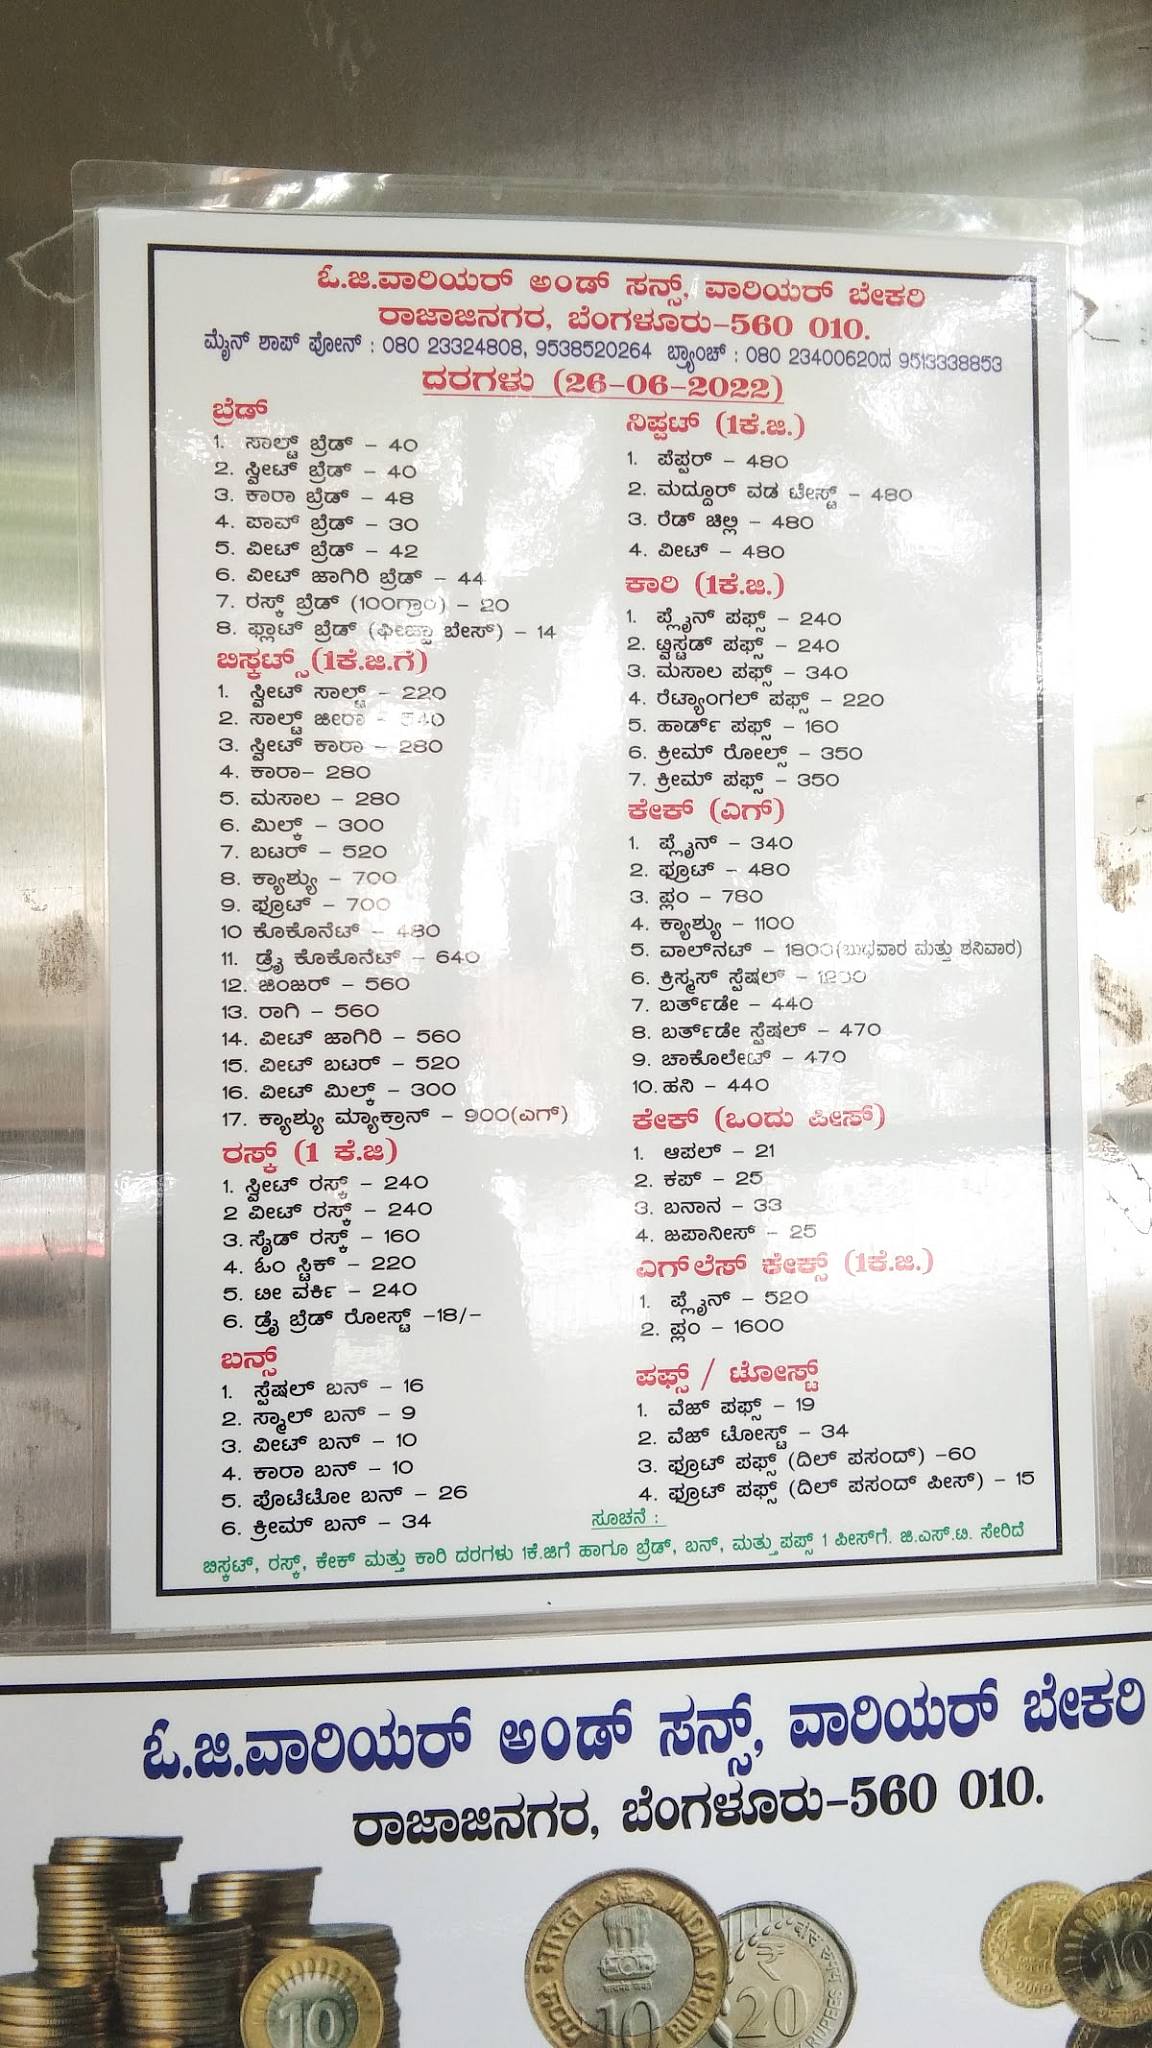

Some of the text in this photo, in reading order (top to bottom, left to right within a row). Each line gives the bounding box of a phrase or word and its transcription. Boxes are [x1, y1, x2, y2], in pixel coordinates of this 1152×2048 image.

[530, 271, 609, 294] ಅಂಡ್
[705, 279, 833, 303] ವಾರಿಯರ್
[849, 281, 925, 308] ಬೇಕರಿ
[378, 304, 551, 331] ರಾಜಾಜಿನಗರ,
[809, 317, 870, 340] 010.
[259, 333, 300, 351] ಶಾಪ್
[383, 336, 419, 354] 080
[428, 337, 527, 359] 23324808,
[536, 339, 652, 359] 9538520264
[746, 346, 781, 364] 080
[899, 352, 1002, 373] 9513338853
[422, 365, 534, 392] ದರಗಳು
[213, 397, 267, 427] ಬ್ರೆಡ್
[626, 411, 699, 441] ನಿಪ್ಪಟ್
[246, 434, 418, 459] ಸಾಲ್ಟ್ ಬ್ರೆಡ್ 40
[658, 449, 788, 474] ಪೆಪ್ಪರ್ 480
[246, 487, 414, 510] ಕಾರಾ ಬ್ರೆಡ್ 48
[246, 513, 418, 537] ಪಾವ್ ಬ್ರೆಡ್ 30
[247, 540, 418, 563] ವೀಟ್ ಬ್ರೆಡ್ 42
[658, 543, 784, 559] ವೀಟ್ 480
[625, 576, 679, 593] ಕಾರಿ
[800, 612, 841, 626] 240
[657, 661, 722, 678] ಮಸಾಲ
[806, 666, 848, 680] 340
[250, 737, 443, 761] ಸ್ವೀಟ್ ಕಾರಾ 280
[655, 743, 863, 767] ಕ್ರೀಮ್ ರೋಲ್ಸ್ 350
[251, 789, 400, 806] ಮಸಾಲ 280
[628, 798, 784, 824] ಕೇಕ್ (ಎಗ್)
[251, 818, 384, 841] ಮಿಲ್ಕ್ 300
[251, 844, 387, 859] ಬಟರ್ 520
[751, 836, 793, 850] 340
[659, 887, 763, 911] ಪ್ಲಂ 780
[253, 922, 440, 938] ಕೊಕೊನೆಟ್ 480
[755, 916, 794, 930] 1100
[729, 968, 785, 992] ಸ್ಪೆಷಲ್
[259, 1003, 379, 1018] ರಾಗಿ 560
[260, 1056, 459, 1072] ವೀಟ್ ಬಟರ್ 520
[663, 1077, 769, 1093] ಹನಿ 440
[633, 1103, 885, 1133] ಕೇಕ್ (ಒಂದು ಪೀಸ್)
[222, 1141, 277, 1174] ರಸ್ಕ್
[294, 1139, 319, 1166] (1
[246, 1175, 428, 1202] ಸ್ವೀಟ್ ರಸ್ಕ್ 240
[664, 1170, 762, 1187] ಕಪ್ 25
[249, 1201, 432, 1226] ವೀಟ್ ರಸ್ಕ್ 240
[664, 1196, 782, 1214] ಬನಾನ 33
[670, 1318, 783, 1343] ಪ್ಲಂ 1600
[221, 1346, 277, 1377] ಬನ್ಸ್
[701, 1358, 715, 1391] /
[730, 1359, 818, 1392] ಟೋಸ್ಟ್
[668, 1399, 710, 1416] ವೆಜ್
[796, 1398, 815, 1411] 19
[253, 1433, 417, 1452] ವೀಟ್ ಬನ್ 10
[668, 1424, 849, 1450] ವೆಜ್ ಟೋಸ್ಟ್ 34
[253, 1460, 413, 1479] ಕಾರಾ ಬನ್ 10
[592, 1507, 646, 1526] ಸೂಚನೆ
[268, 1554, 306, 1579] ರಸ್ಕ್,
[316, 1552, 356, 1569] ಕೇಕ್
[365, 1549, 405, 1572] ಮತ್ತು
[415, 1548, 447, 1564] ಕಾರಿ
[456, 1544, 513, 1563] ದರಗಳು
[579, 1539, 628, 1557] ಹಾಗೂ
[637, 1538, 676, 1561] ಬ್ರೆಡ್,
[685, 1536, 723, 1553] ಬನ್,
[732, 1533, 779, 1556] ಮತ್ತು
[822, 1533, 827, 1547] 1
[981, 1521, 1024, 1539] ಸೇರಿದೆ
[500, 1699, 632, 1764] ಅಂಡ್
[790, 1678, 998, 1748] ವಾರಿಯರ್
[1024, 1669, 1145, 1733] ಬೇಕರಿ
[353, 1802, 599, 1846] ರಾಜಾಜಿನಗರ,
[959, 1766, 1043, 1809] 010.
[669, 1890, 714, 1959] INDIA
[278, 1998, 345, 2048] 10
[735, 1984, 809, 2040] 20
